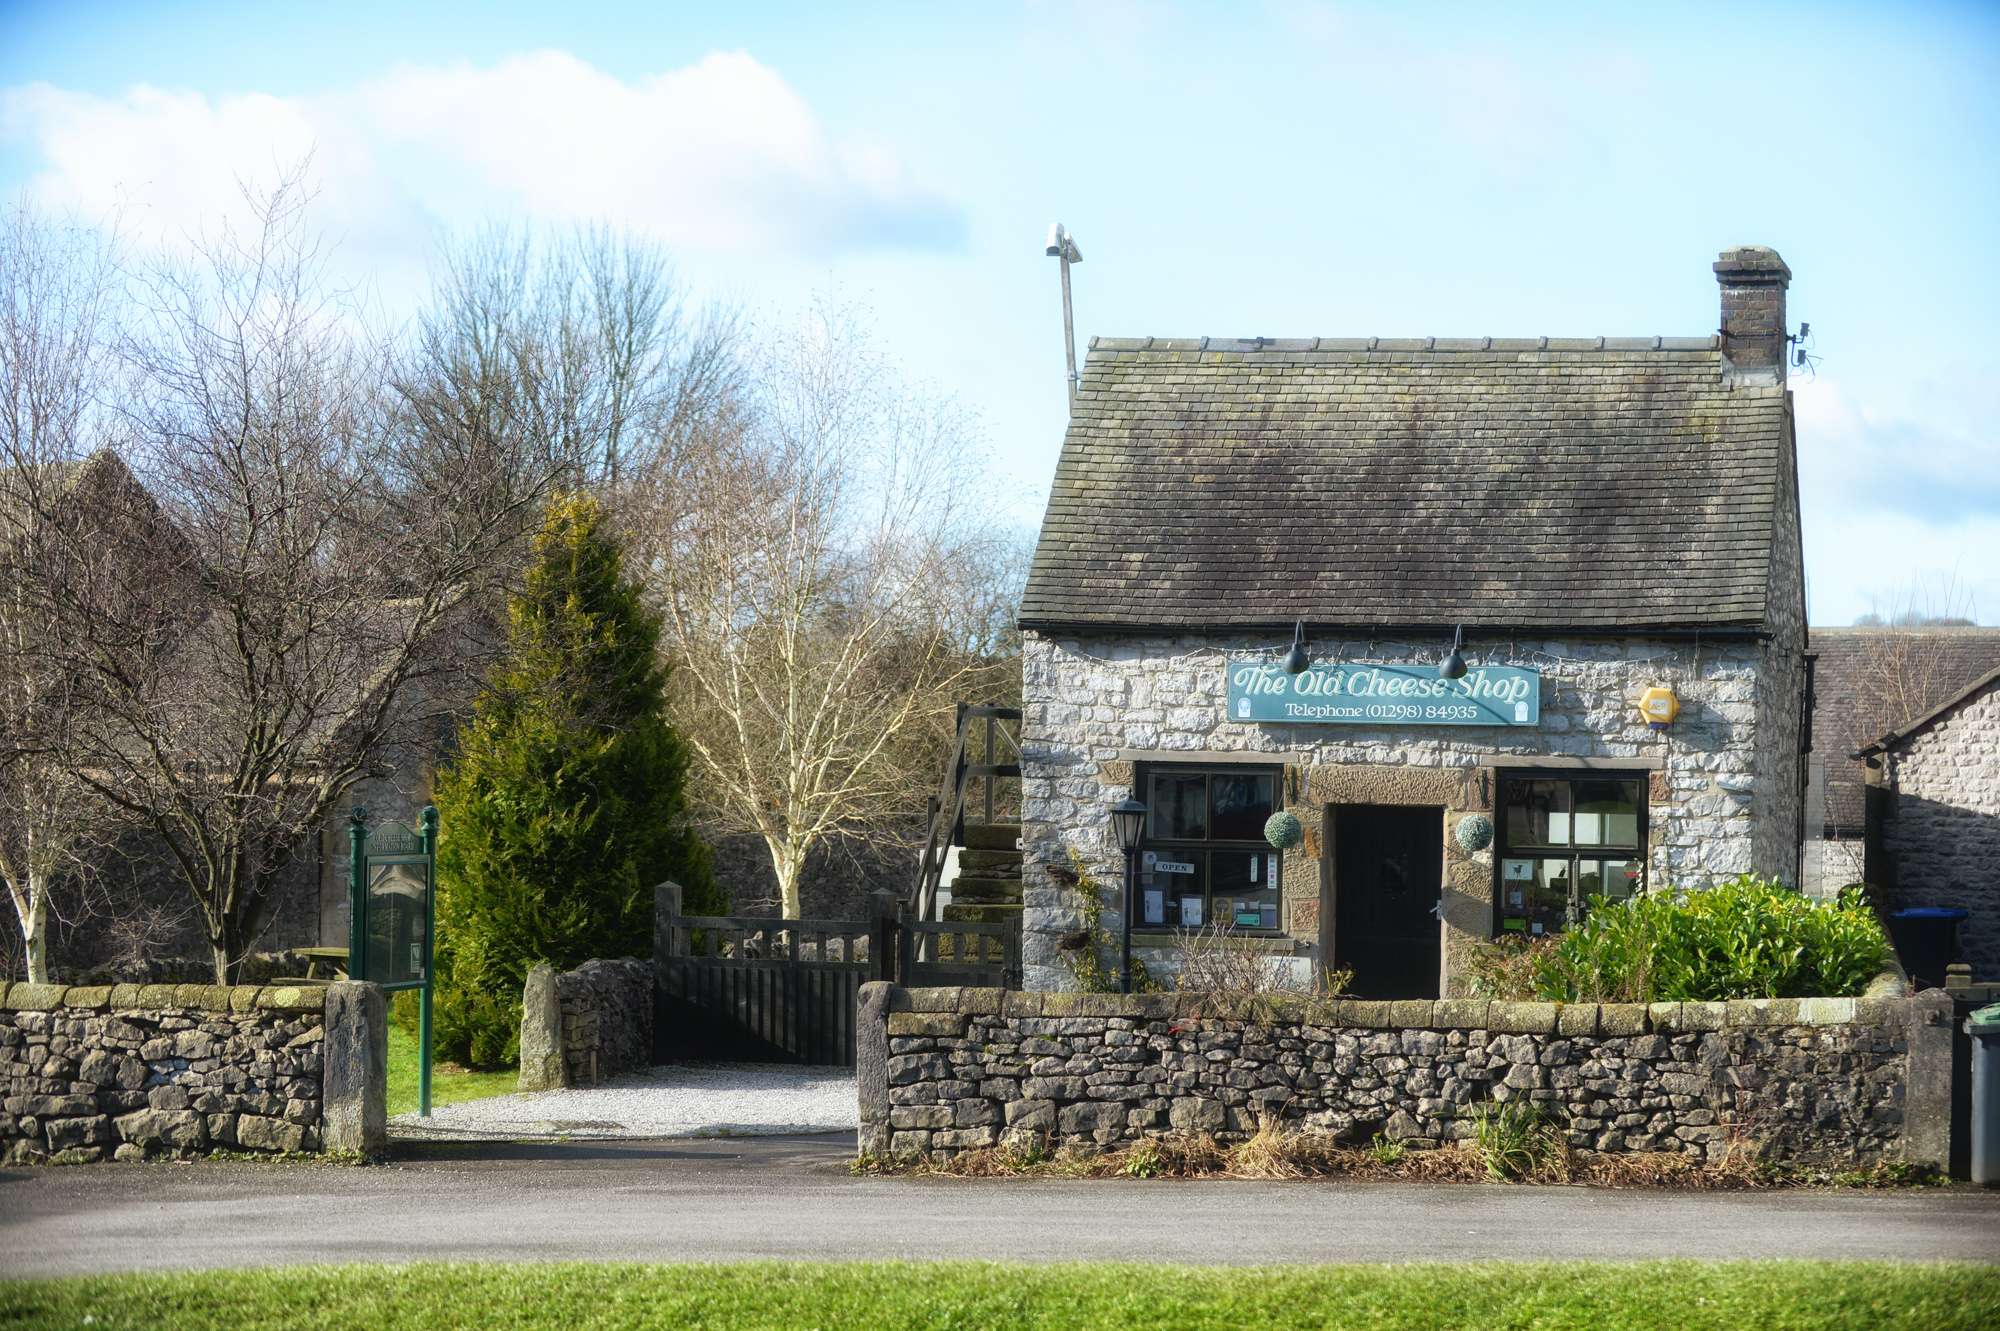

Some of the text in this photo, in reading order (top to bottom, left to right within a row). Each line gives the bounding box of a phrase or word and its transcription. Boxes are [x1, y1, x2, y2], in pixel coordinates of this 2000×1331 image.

[1234, 666, 1530, 704] The Old Cheese Shop
[1285, 703, 1477, 720] Telephone (01298) 84935
[1162, 863, 1188, 872] OPEN
